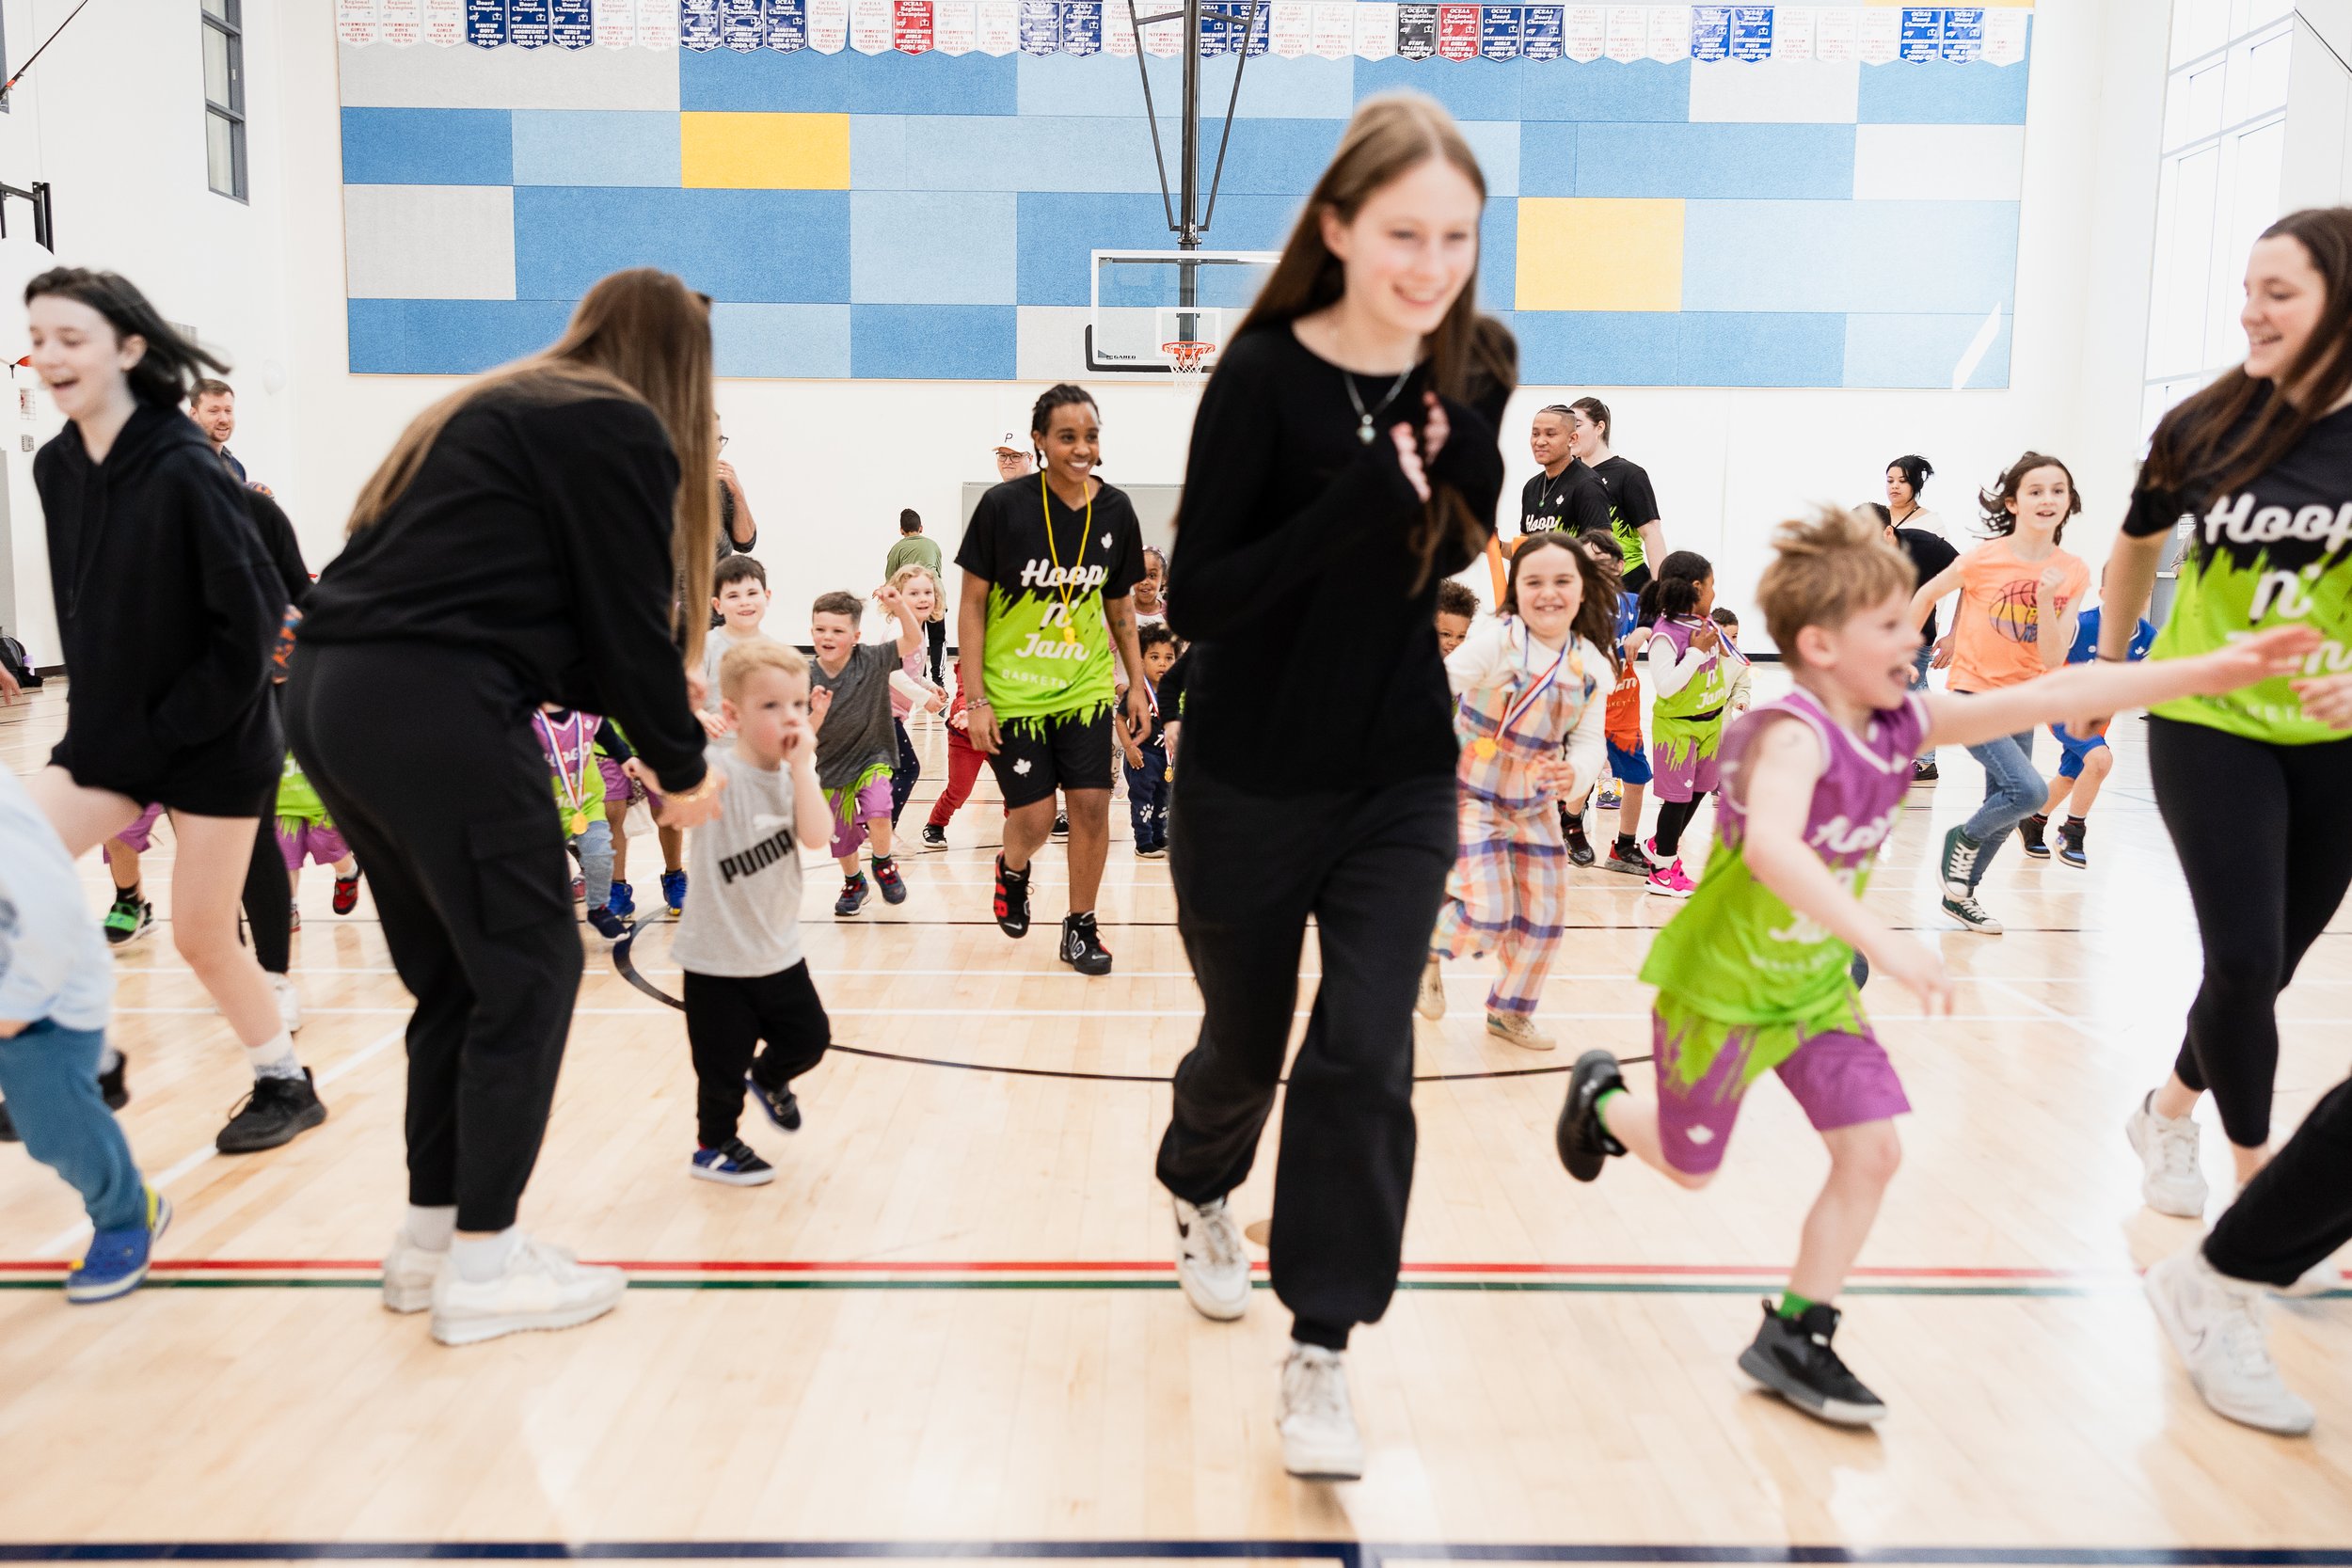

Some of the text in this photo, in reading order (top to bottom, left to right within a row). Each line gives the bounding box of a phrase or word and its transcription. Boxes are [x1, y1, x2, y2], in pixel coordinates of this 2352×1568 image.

[1004, 433, 1013, 443] P
[1526, 514, 1558, 533] Hoop
[1020, 559, 1106, 593] Hoop
[1015, 633, 1089, 661] Jam
[1002, 669, 1074, 689] BASKETB
[719, 828, 796, 884] PUMA
